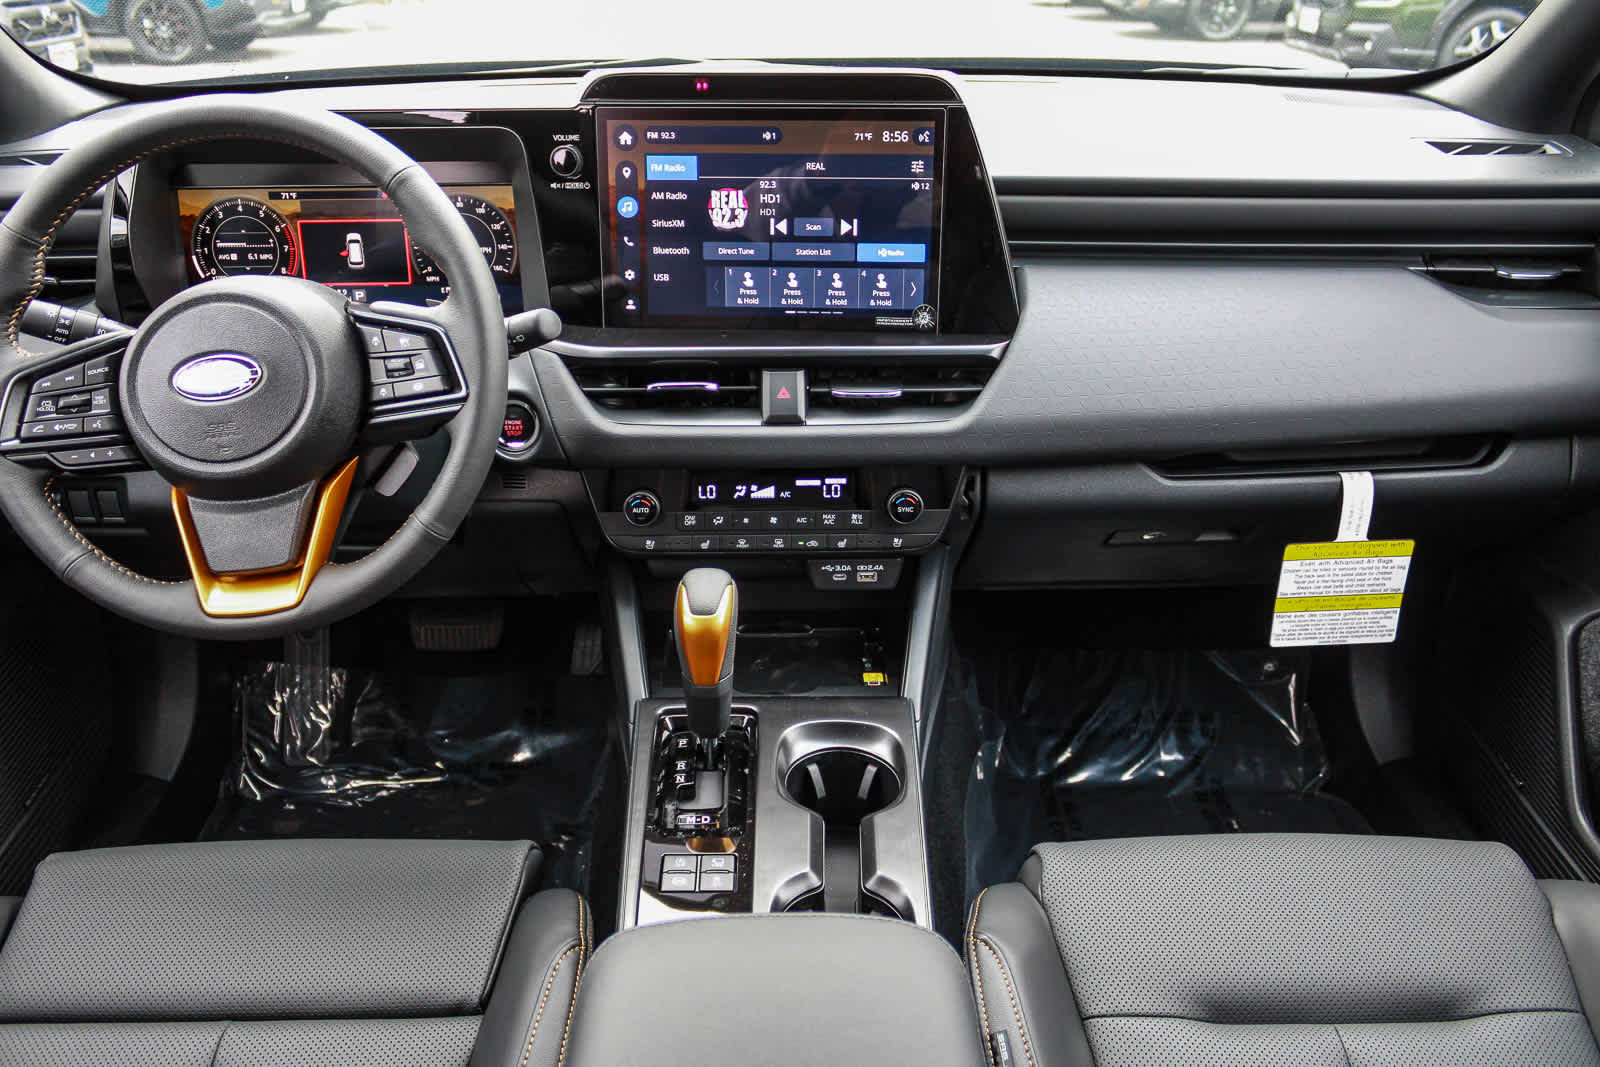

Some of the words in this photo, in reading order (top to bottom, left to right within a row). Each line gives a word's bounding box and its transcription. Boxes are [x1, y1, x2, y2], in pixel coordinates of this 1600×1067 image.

[882, 130, 909, 142] 8:56
[650, 164, 663, 172] FM
[664, 164, 686, 172] Radio
[806, 162, 826, 170] REAL
[760, 181, 776, 189] 92.3
[651, 192, 664, 200] AM
[666, 192, 688, 200] Radio
[710, 190, 746, 208] REAL
[760, 194, 780, 204] HD1
[760, 208, 776, 216] HD1
[712, 208, 745, 228] 92.3
[652, 220, 685, 228] SiriusXM
[653, 247, 690, 255] Bluetooth
[355, 291, 364, 301] P
[678, 740, 688, 748] P
[676, 762, 687, 770] R
[676, 776, 685, 784] N
